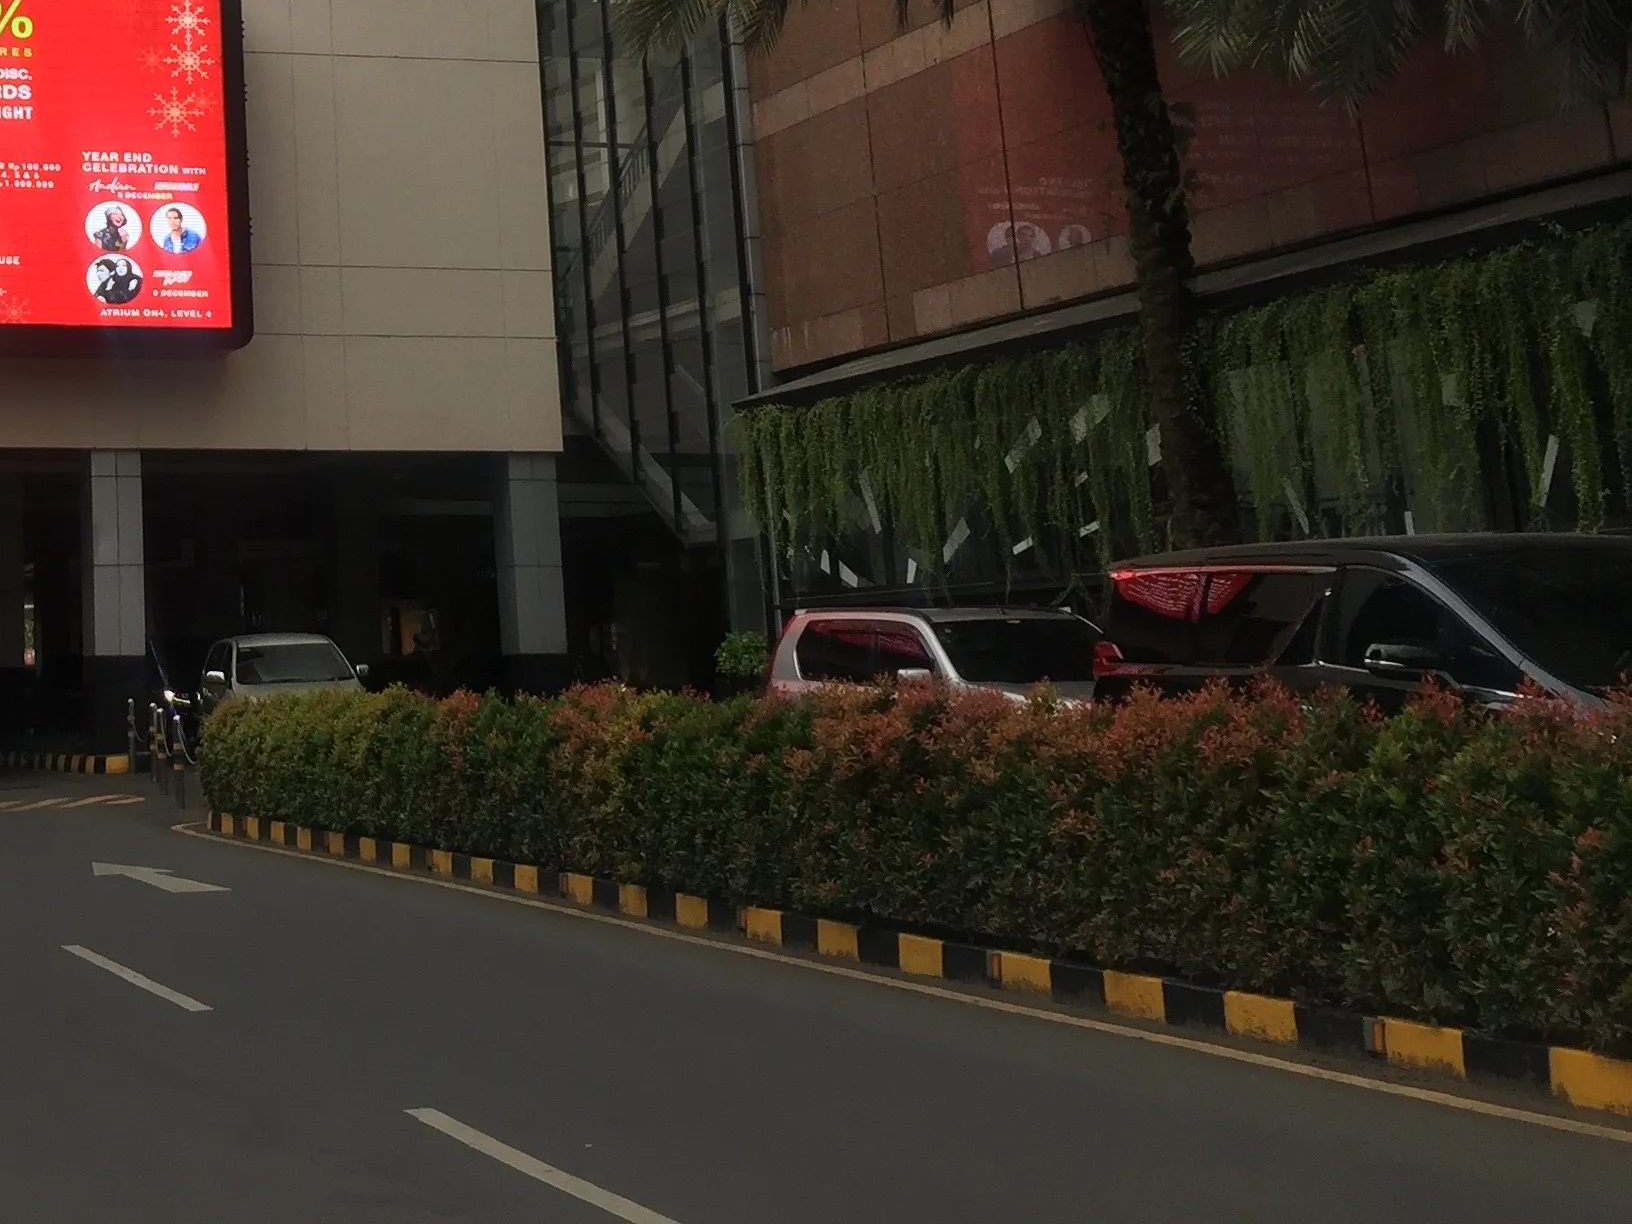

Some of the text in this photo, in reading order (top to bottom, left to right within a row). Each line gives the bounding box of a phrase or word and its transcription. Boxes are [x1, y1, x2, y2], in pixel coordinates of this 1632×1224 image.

[82, 151, 153, 162] YEAR END
[82, 163, 206, 175] CELEBRATION WITH
